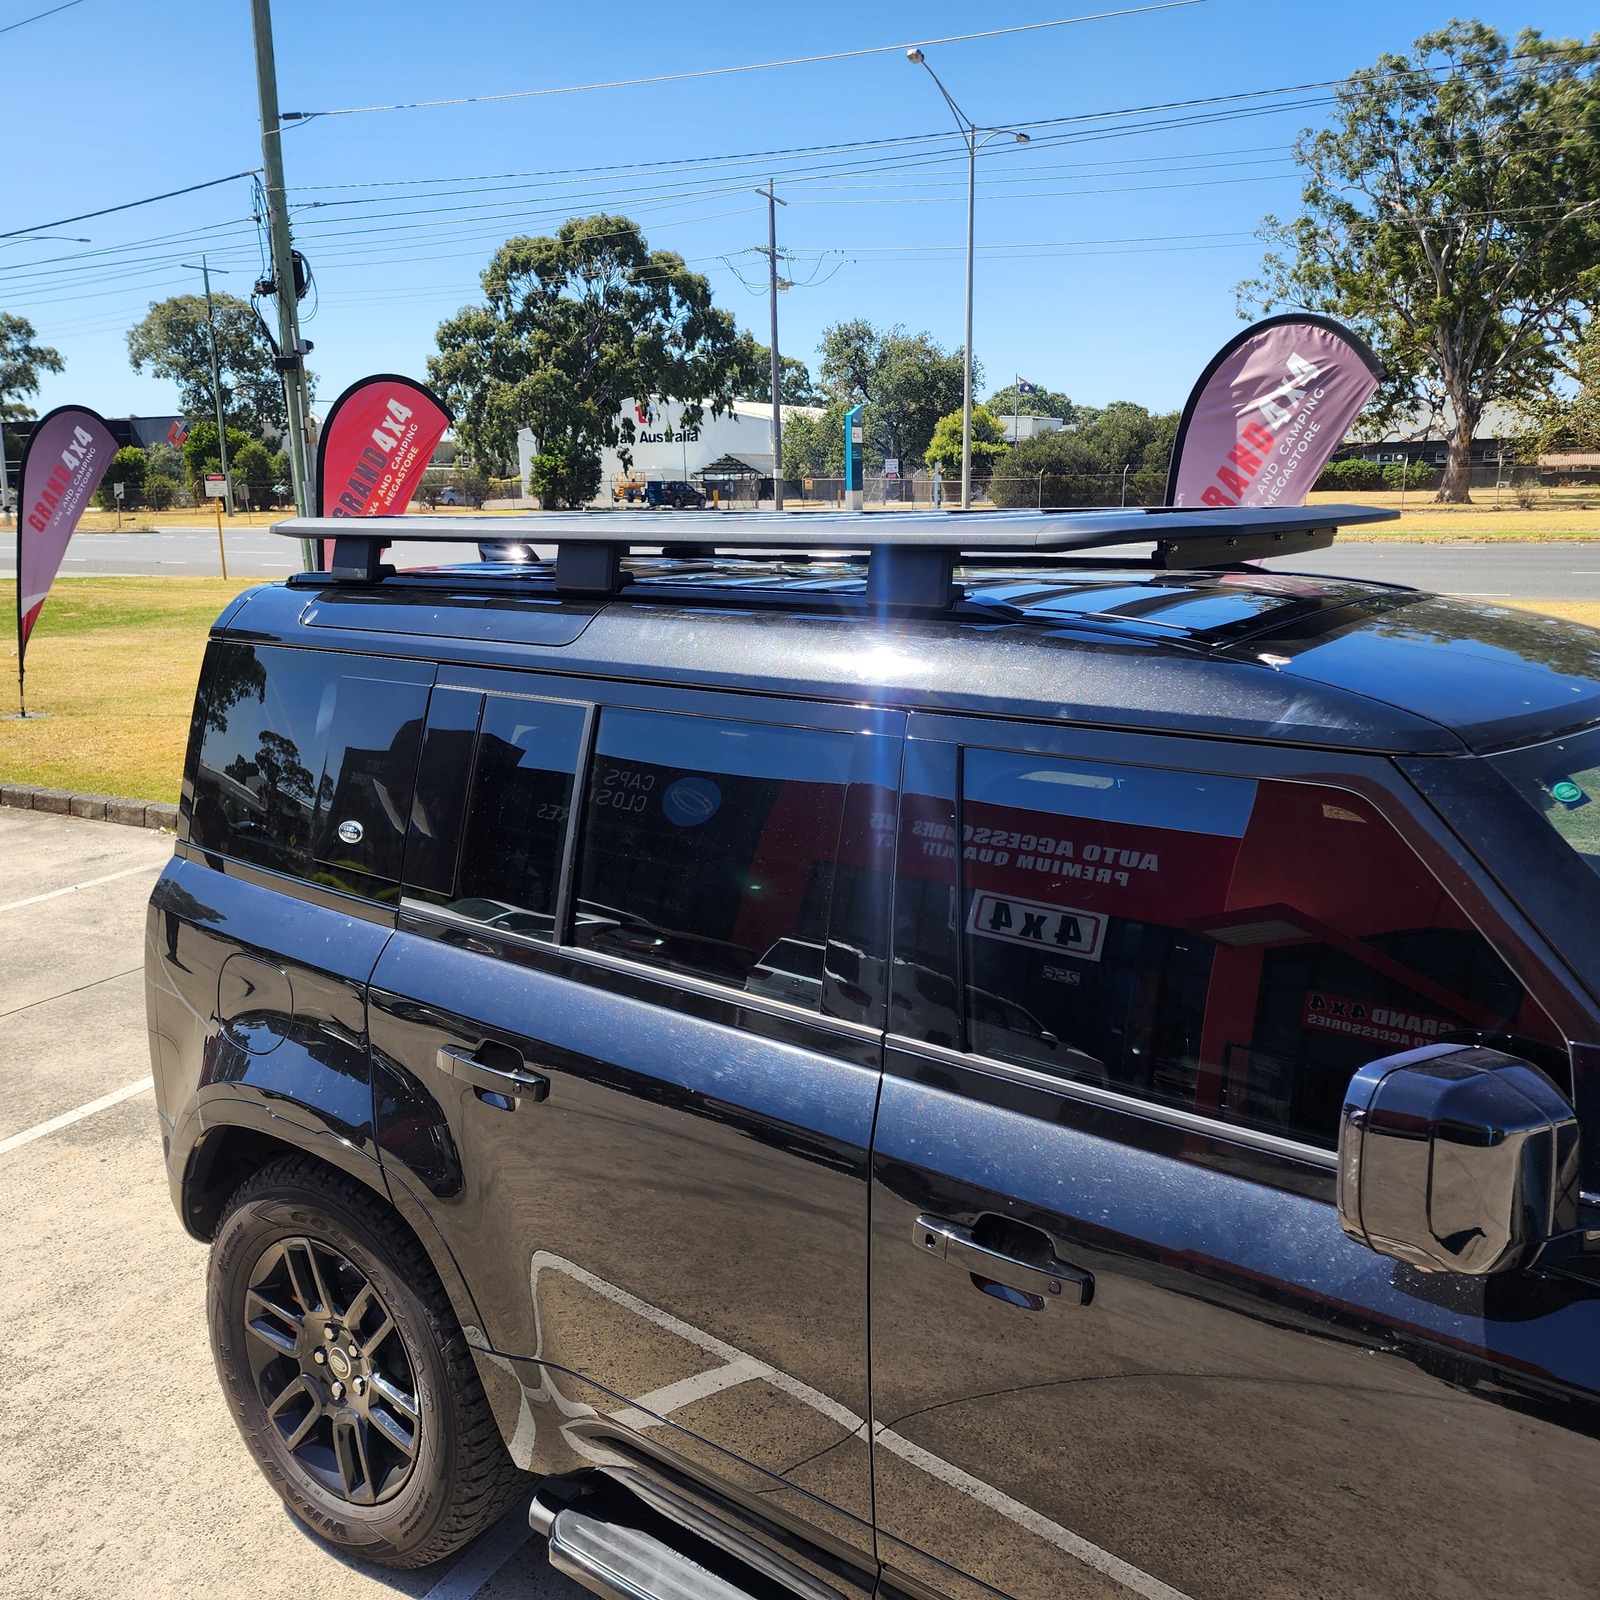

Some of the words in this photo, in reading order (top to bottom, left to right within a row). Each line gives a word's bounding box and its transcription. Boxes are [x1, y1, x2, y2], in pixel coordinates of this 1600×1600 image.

[640, 430, 699, 443] Ausalia
[1256, 462, 1278, 496] AND
[1279, 387, 1325, 456] CAMPING
[1264, 421, 1321, 507] MEGASTORE
[27, 464, 73, 533] GRAND
[62, 489, 74, 508] AND
[73, 447, 96, 486] CAMPING
[66, 466, 94, 516] MEGASTORE
[366, 501, 379, 517] X4
[377, 474, 392, 497] AND
[391, 423, 418, 470] CAMPING
[384, 446, 419, 506] MEGASTORE
